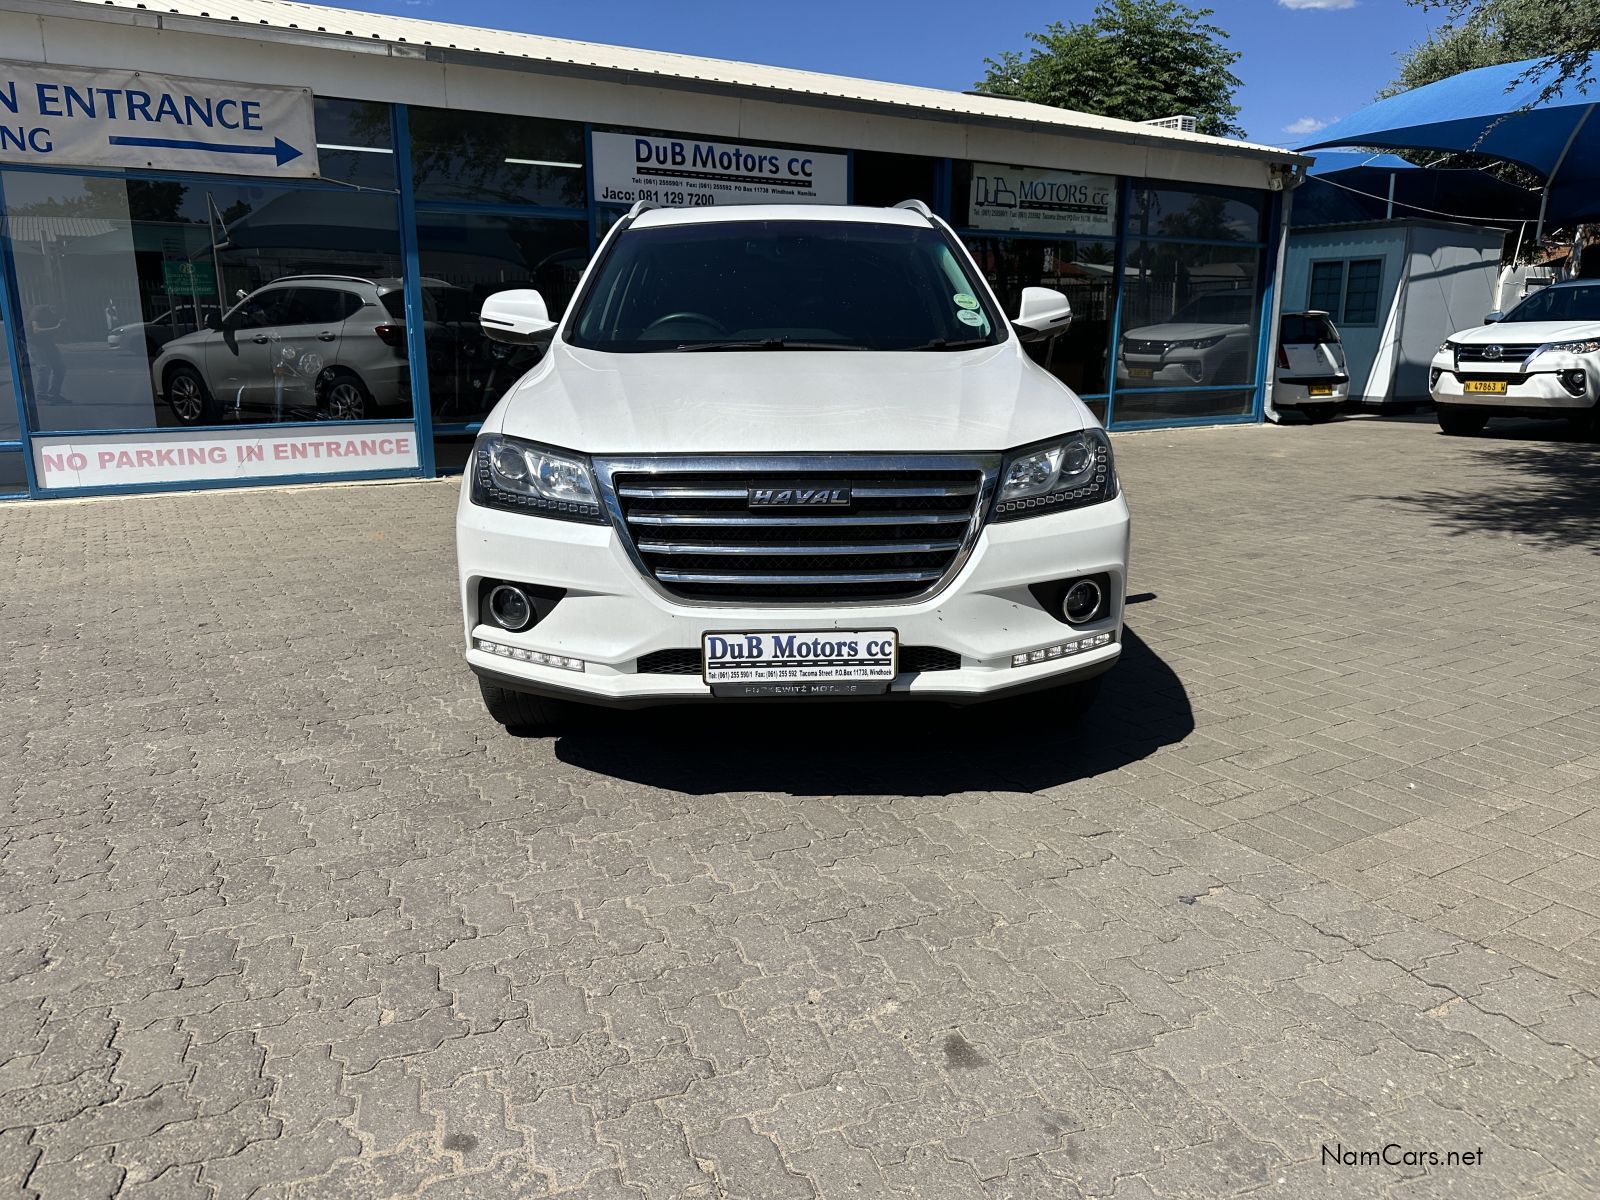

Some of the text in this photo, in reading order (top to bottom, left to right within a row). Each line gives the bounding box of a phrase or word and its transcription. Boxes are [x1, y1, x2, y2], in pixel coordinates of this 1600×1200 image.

[35, 83, 263, 131] ENTRANCE
[635, 139, 813, 177] DuB Motors cc
[602, 187, 715, 205] Jaco: 081 129 7200
[699, 182, 712, 190] (061)
[1019, 180, 1088, 203] MOTORS
[1474, 383, 1496, 391] 47863
[43, 438, 410, 472] NO PARKING IN ENTRANCE
[752, 490, 848, 504] HAVAL
[708, 635, 892, 660] DuB Motors cc
[718, 671, 729, 680] (061)
[766, 670, 777, 679] (061)
[799, 669, 817, 677] Tacoma
[870, 668, 892, 676] Windhoek
